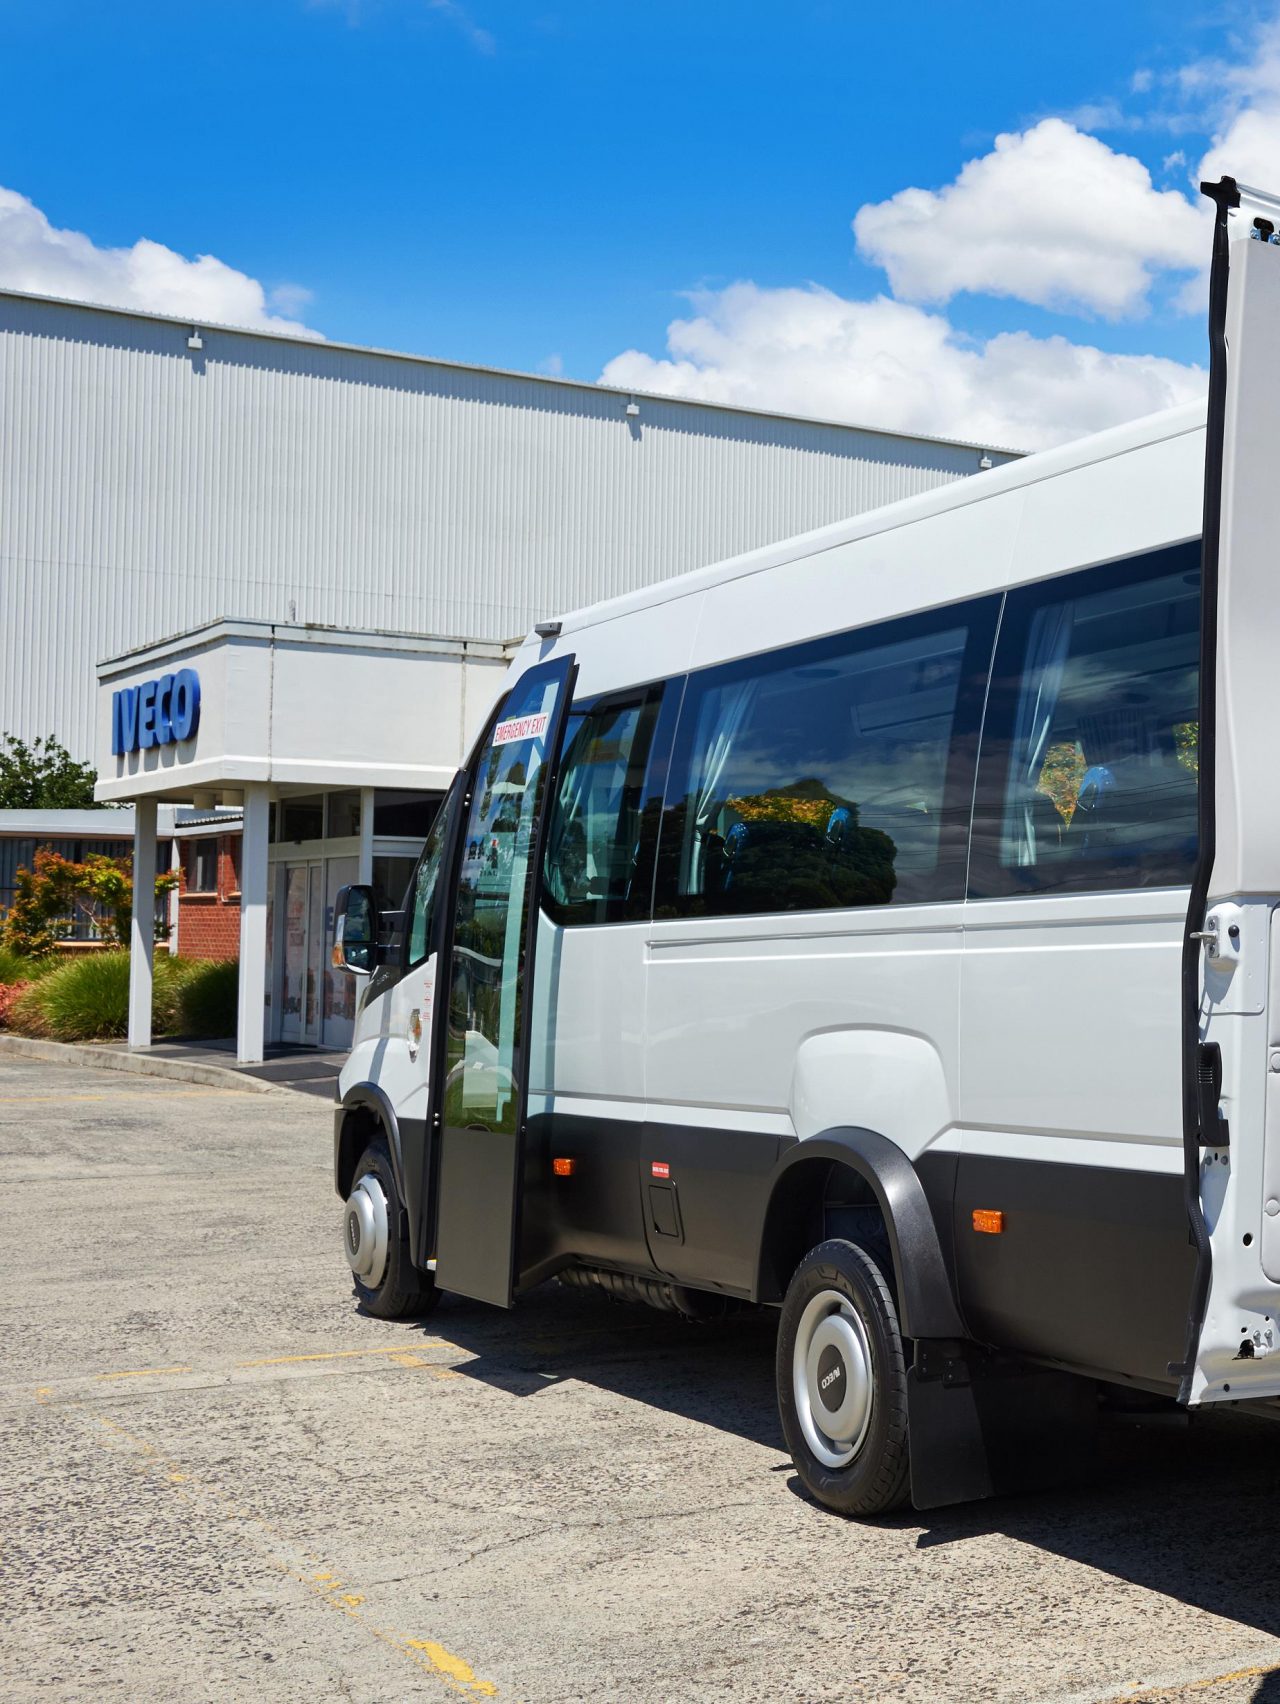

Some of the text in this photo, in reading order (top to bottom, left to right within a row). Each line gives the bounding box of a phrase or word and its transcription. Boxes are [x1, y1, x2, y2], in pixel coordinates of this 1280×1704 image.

[112, 668, 200, 755] IVECO
[495, 716, 547, 743] EMERGENCY EXIT
[821, 1366, 840, 1389] IVECO
